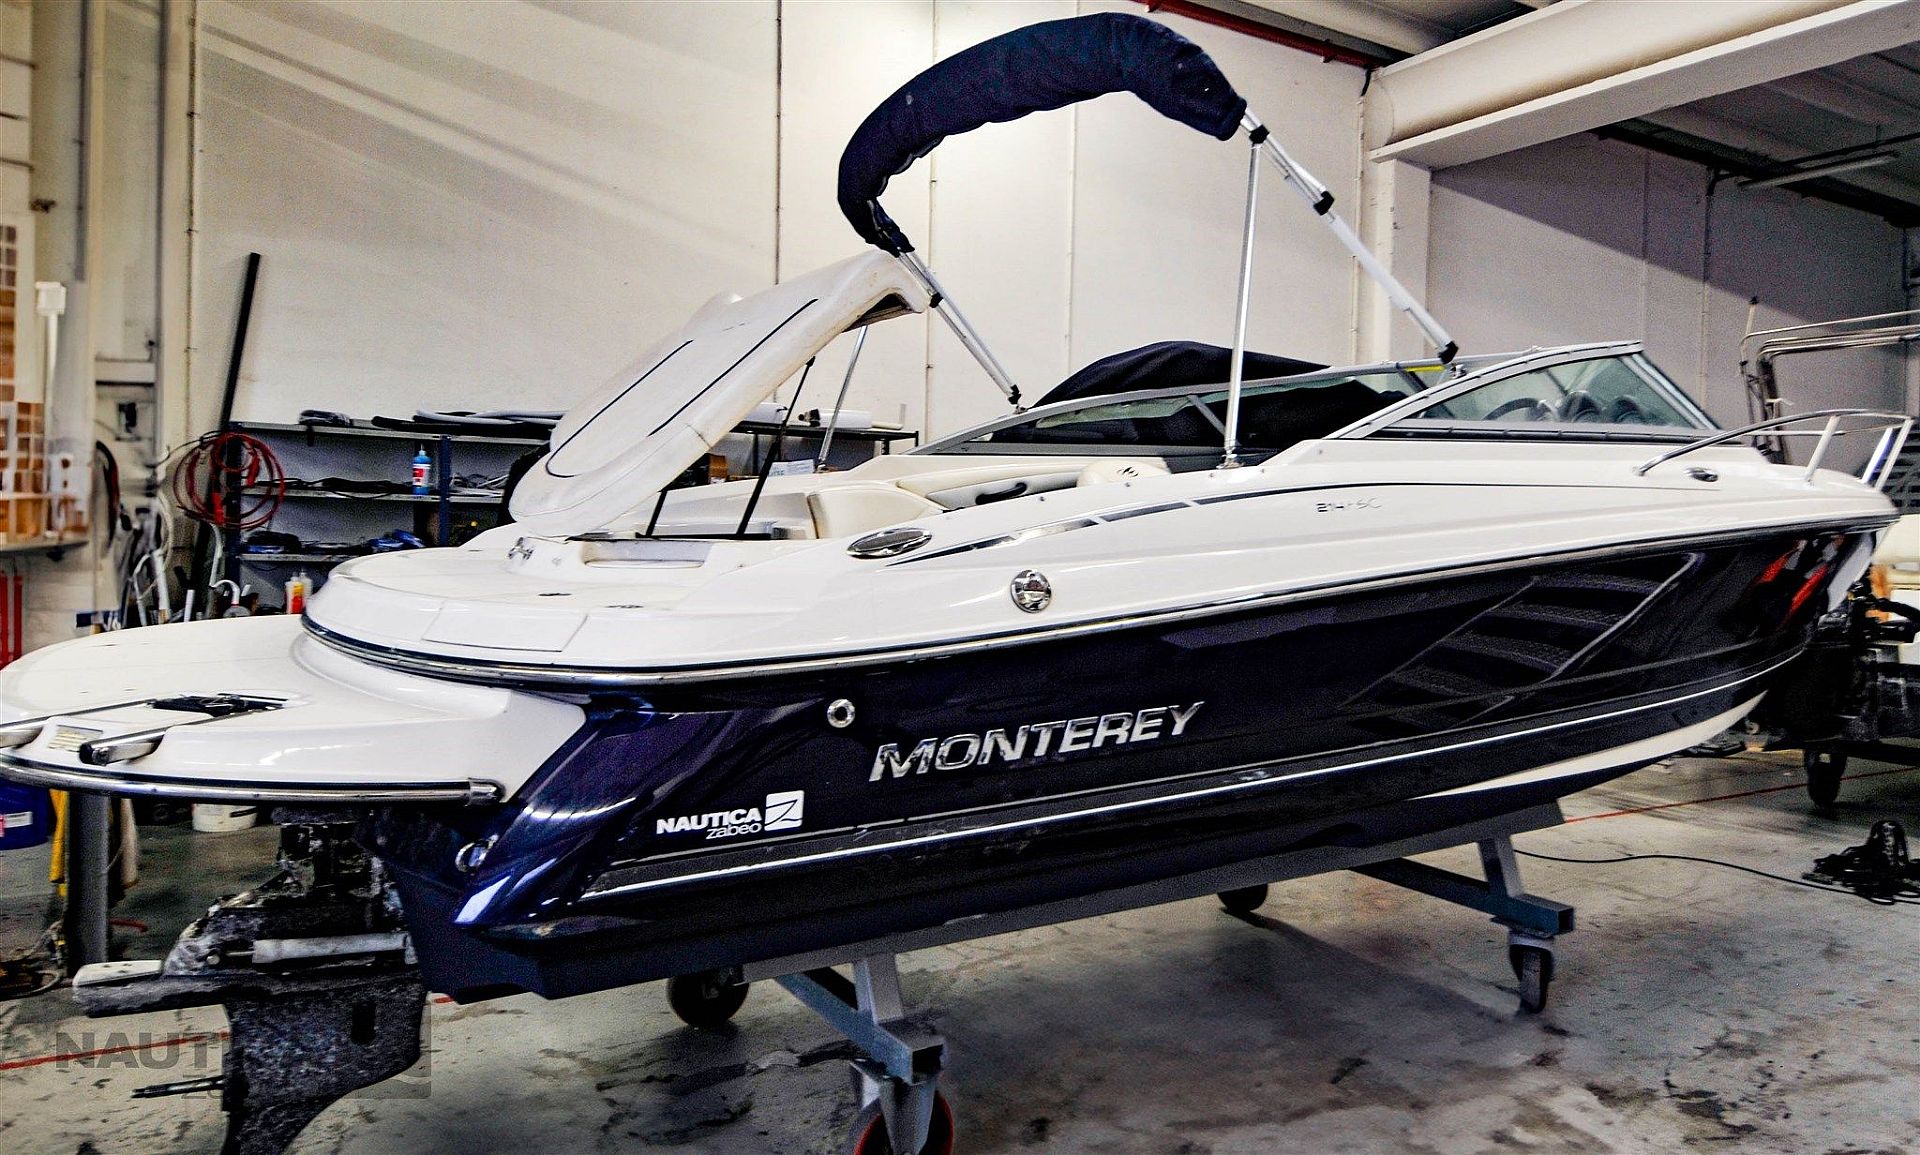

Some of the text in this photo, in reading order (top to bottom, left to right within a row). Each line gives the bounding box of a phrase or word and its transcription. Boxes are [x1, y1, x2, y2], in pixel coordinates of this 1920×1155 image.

[868, 700, 1205, 782] MONTEREY
[656, 807, 762, 834] NAUTICA
[705, 822, 762, 840] zabeo
